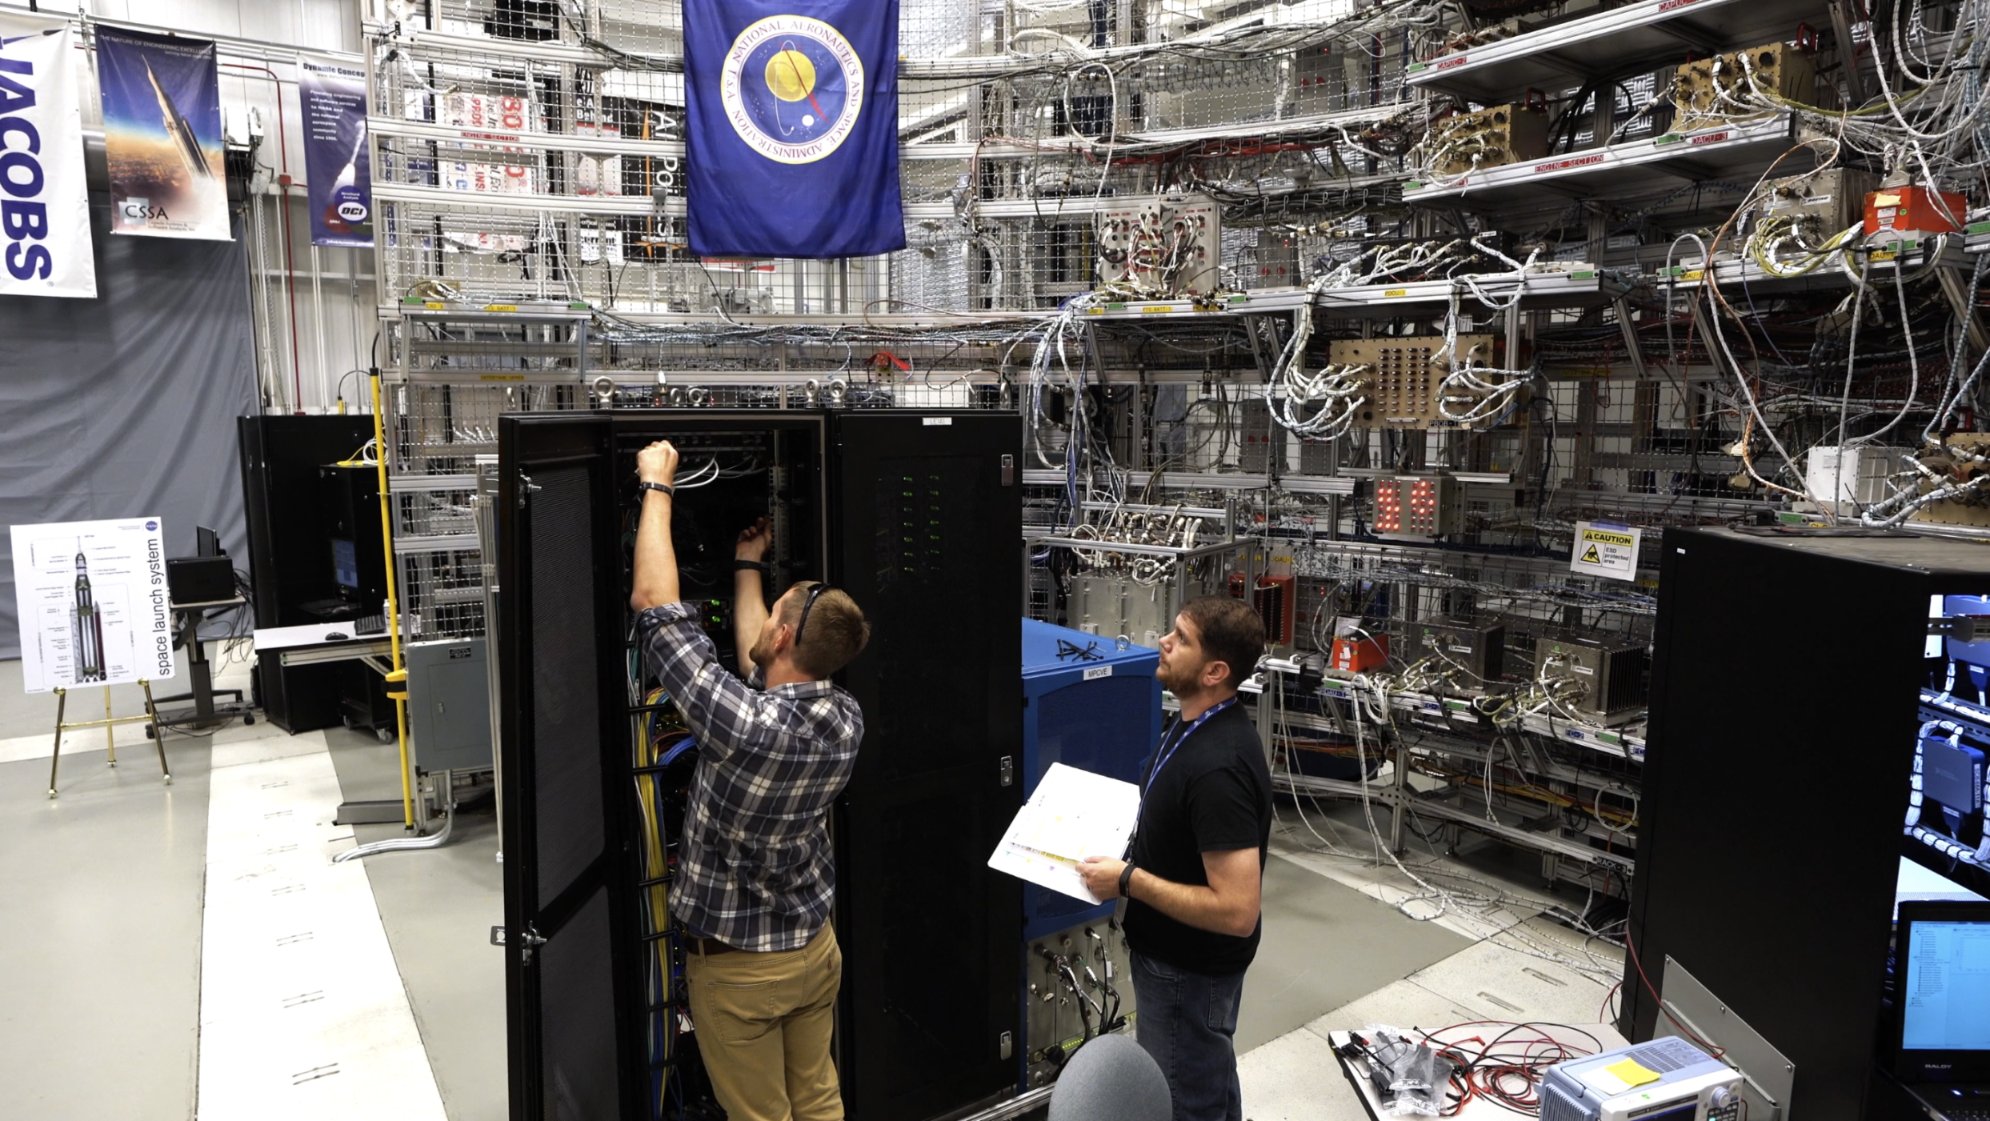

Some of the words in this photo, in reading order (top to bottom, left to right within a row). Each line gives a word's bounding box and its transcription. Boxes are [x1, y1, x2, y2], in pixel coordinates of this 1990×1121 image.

[111, 36, 133, 44] NATURE
[732, 20, 785, 63] NATIONAL
[790, 20, 859, 76] AERONAUTICS
[303, 62, 336, 74] Dynamic
[851, 80, 860, 107] AND
[734, 110, 823, 158] ADMINISTRATION
[830, 113, 854, 146] SPACE
[125, 205, 169, 220] CSSA
[342, 207, 364, 215] DCI
[1594, 533, 1631, 544] CAUTION
[147, 538, 164, 585] system
[149, 590, 166, 633] launch
[156, 636, 172, 676] space
